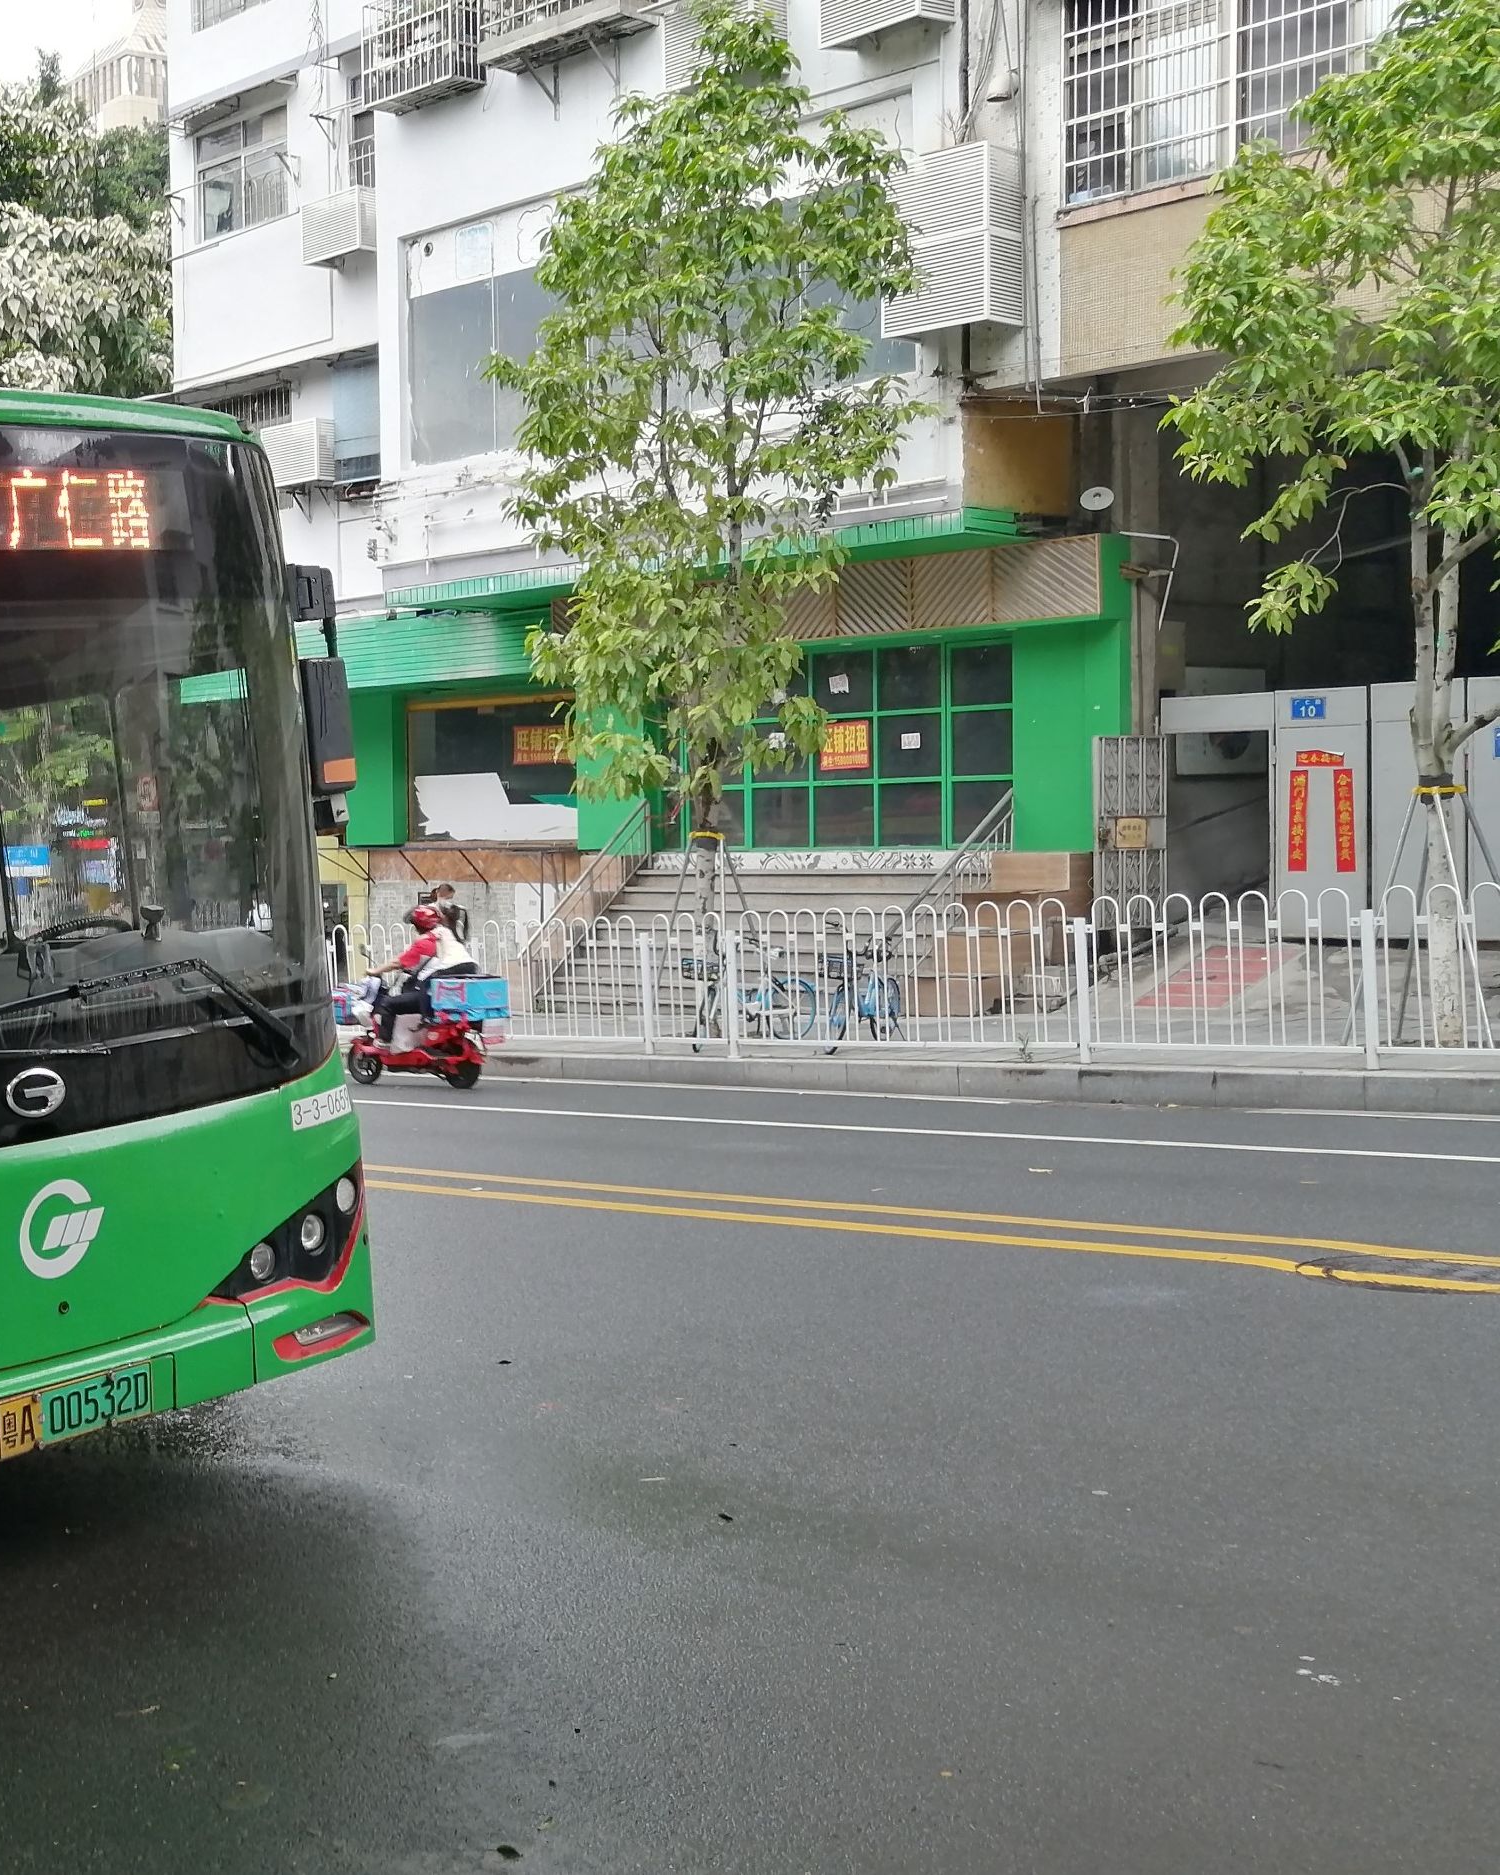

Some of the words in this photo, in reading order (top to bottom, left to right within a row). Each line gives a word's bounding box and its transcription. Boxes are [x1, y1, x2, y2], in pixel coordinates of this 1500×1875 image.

[1300, 705, 1316, 717] 10
[2, 1404, 36, 1450] 粤A
[49, 1371, 149, 1435] 00532D
